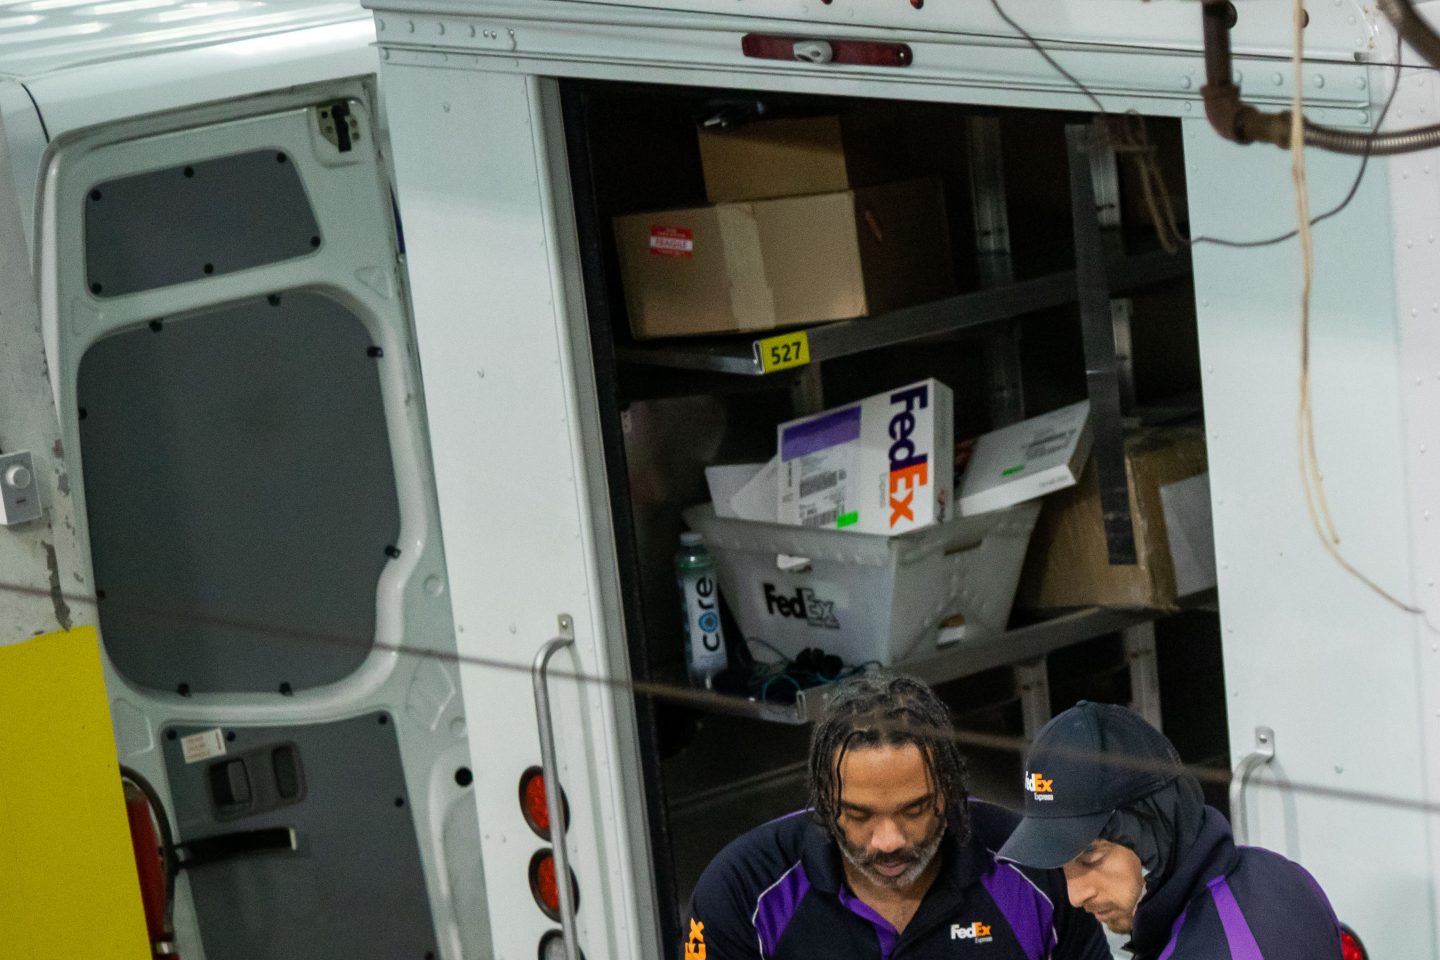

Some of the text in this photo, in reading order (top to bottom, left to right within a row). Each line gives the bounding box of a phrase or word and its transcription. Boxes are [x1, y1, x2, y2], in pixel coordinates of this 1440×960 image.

[771, 341, 801, 365] 527
[888, 384, 928, 529] FedEx
[696, 577, 720, 652] core
[763, 582, 836, 623] FedEx
[950, 921, 992, 940] FedEx
